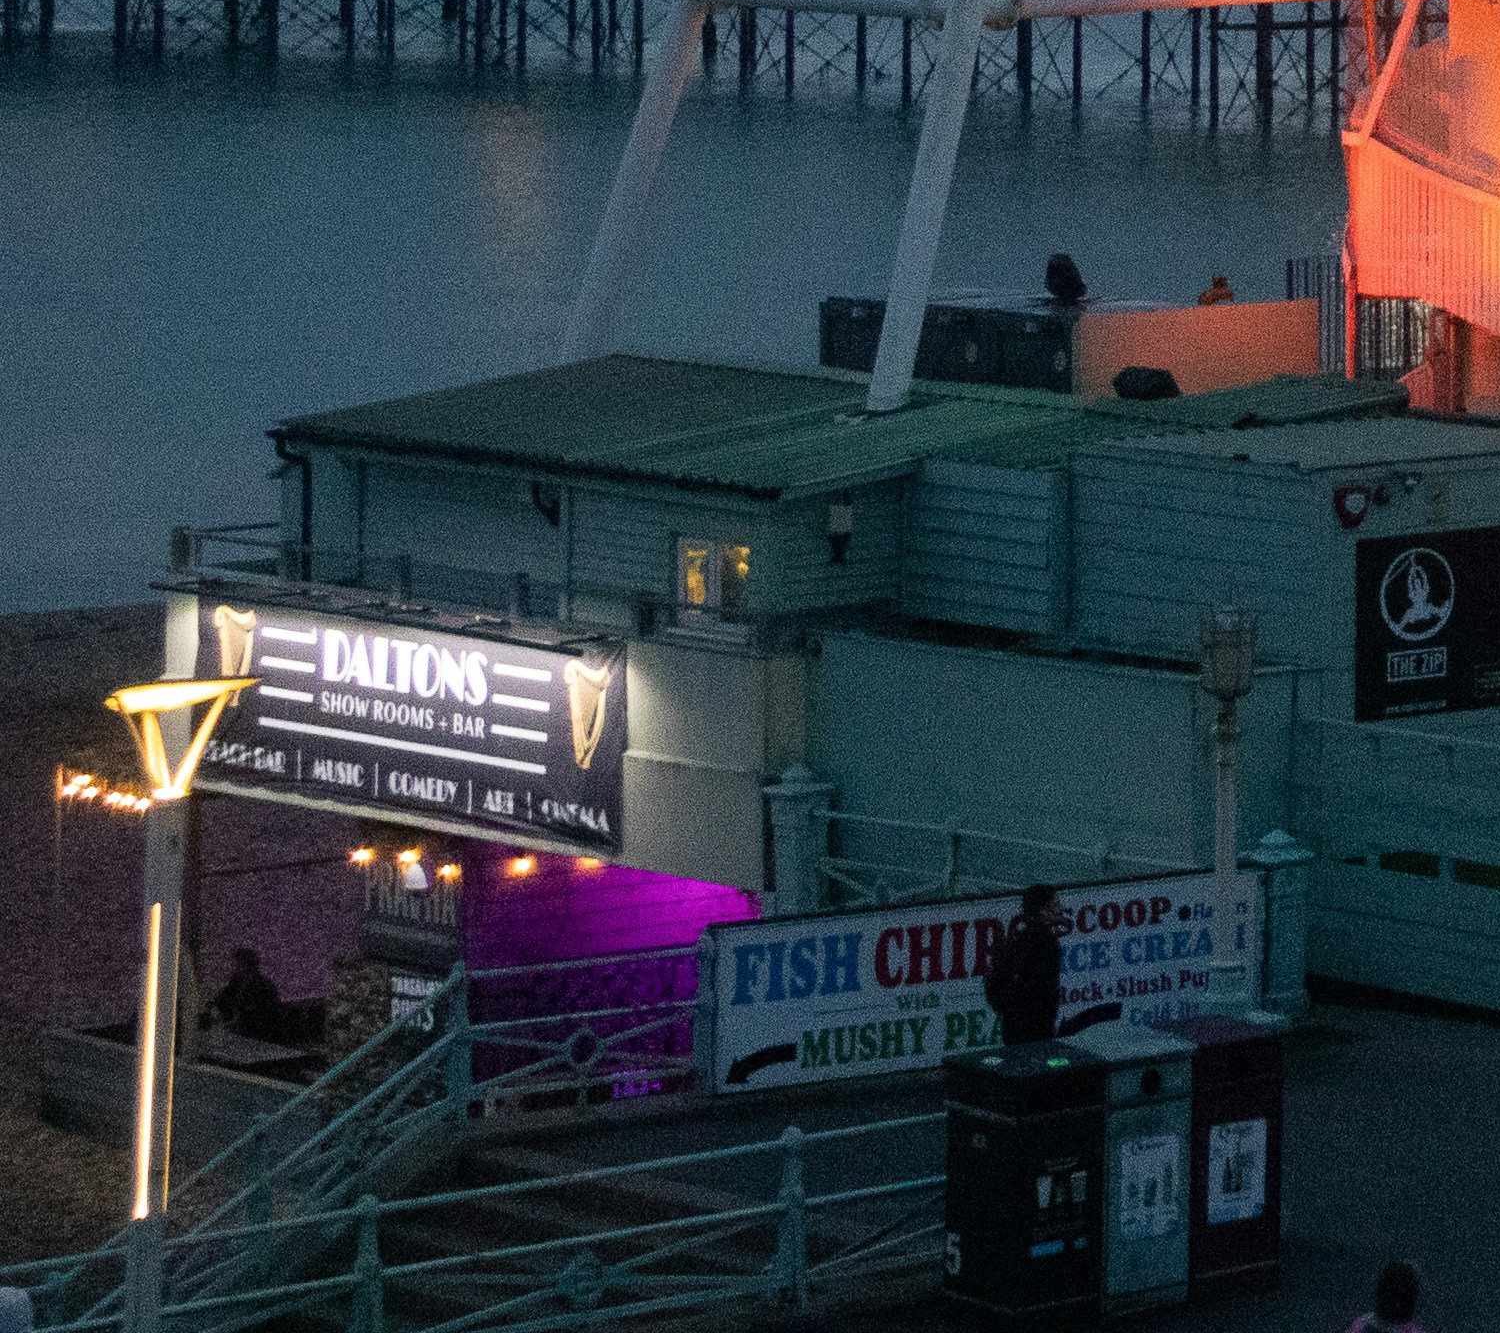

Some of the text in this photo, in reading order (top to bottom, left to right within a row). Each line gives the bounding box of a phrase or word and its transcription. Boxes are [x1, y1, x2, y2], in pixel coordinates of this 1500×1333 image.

[322, 628, 489, 707] DALTONS
[1391, 653, 1444, 678] THE ZIP
[321, 690, 370, 719] SHOW
[372, 699, 435, 730] ROOMS
[452, 712, 486, 739] BAR
[312, 758, 365, 788] MUSIC
[388, 770, 459, 803] COMEDY
[483, 789, 515, 815] ART
[1059, 897, 1172, 937] SCOOP
[731, 933, 863, 1006] FISH
[1115, 972, 1173, 998] Slush
[897, 990, 942, 1011] With
[801, 1009, 1004, 1069] MUSHY PEA
[945, 1231, 962, 1276] 5
